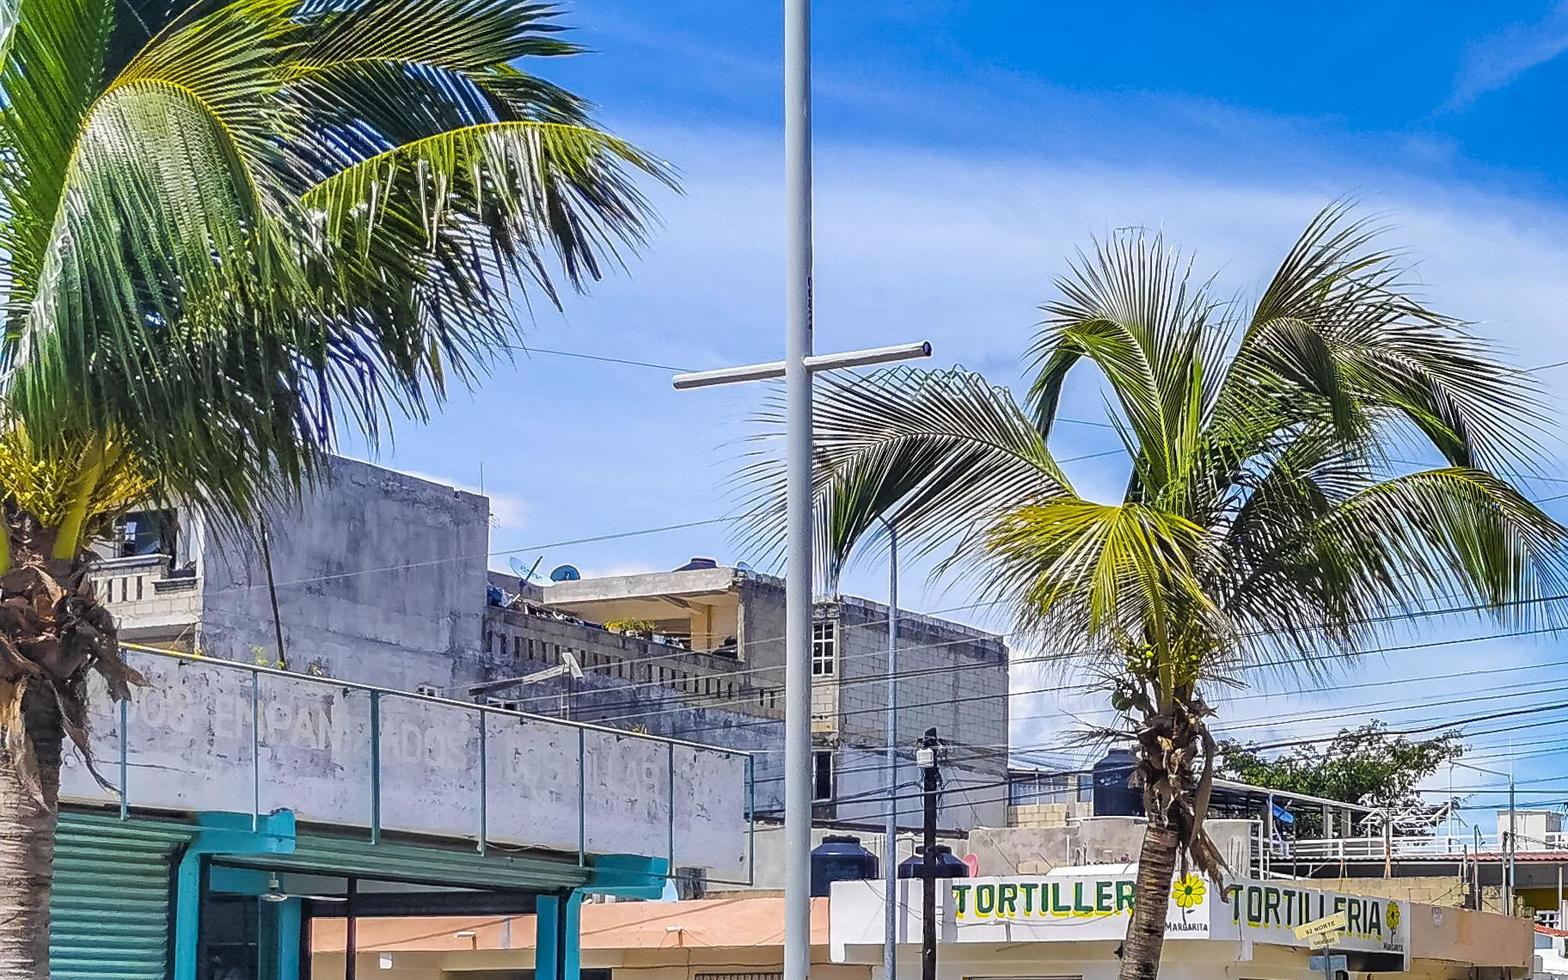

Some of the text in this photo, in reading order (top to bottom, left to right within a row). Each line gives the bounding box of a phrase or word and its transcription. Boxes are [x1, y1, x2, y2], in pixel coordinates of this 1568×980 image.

[952, 880, 1137, 917] TORTILLER
[1229, 884, 1382, 936] TORTILLERIA
[1165, 921, 1208, 932] MARGARITA
[1314, 921, 1335, 932] NORTE
